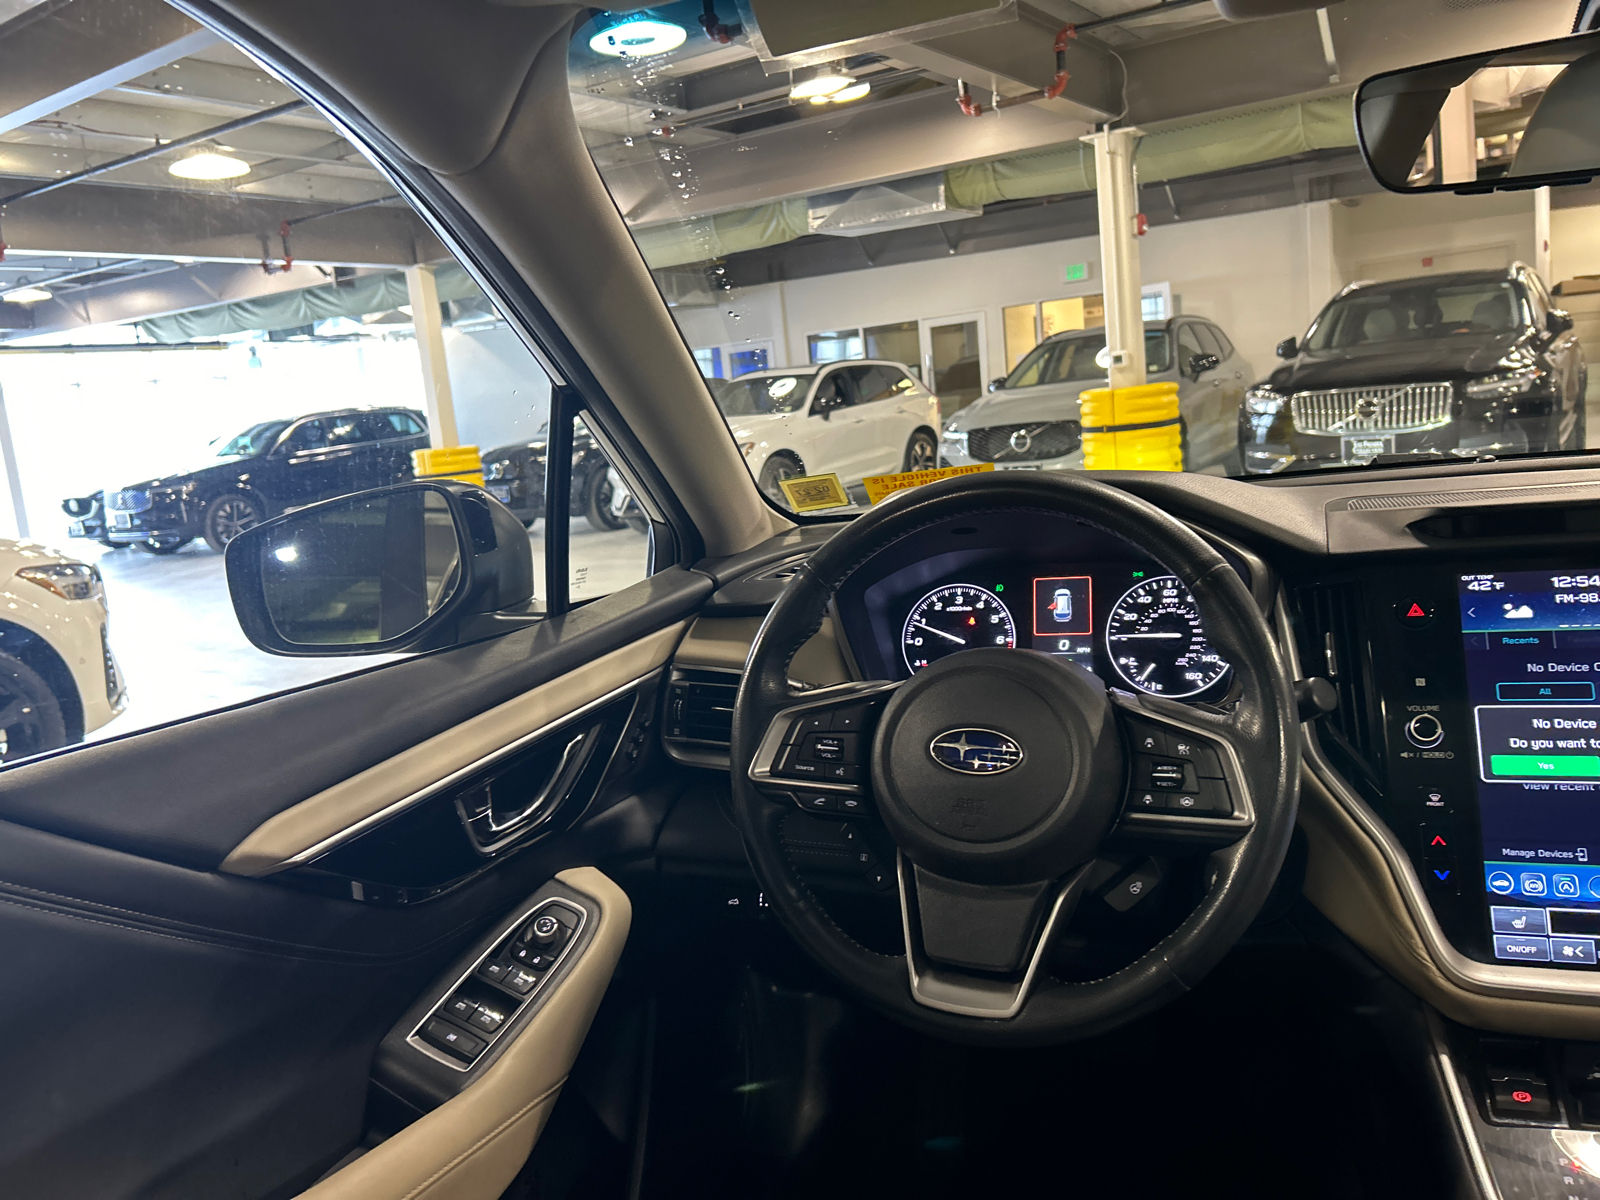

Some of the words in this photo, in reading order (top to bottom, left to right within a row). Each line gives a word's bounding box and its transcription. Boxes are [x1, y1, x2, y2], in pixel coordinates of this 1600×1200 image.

[1550, 575, 1600, 588] 12:54
[955, 596, 964, 604] 3
[1137, 596, 1152, 604] 40
[934, 602, 943, 611] 2
[976, 601, 985, 609] 4
[990, 615, 1000, 624] 5
[1123, 613, 1138, 621] 20
[914, 637, 923, 646] 0
[996, 636, 1006, 645] 6
[1058, 639, 1069, 650] 0
[1527, 663, 1544, 672] No
[1548, 662, 1590, 672] Device
[1185, 672, 1202, 680] 160
[1532, 719, 1551, 729] No
[1554, 718, 1597, 729] Device
[1509, 738, 1528, 748] Do
[1531, 740, 1554, 750] you
[1556, 738, 1587, 748] want
[1537, 762, 1555, 770] Yes
[1502, 848, 1536, 858] Manage
[1538, 849, 1574, 858] Devices
[1506, 945, 1537, 953] ON/OFF
[1559, 1158, 1569, 1166] P
[1563, 1176, 1574, 1185] R
